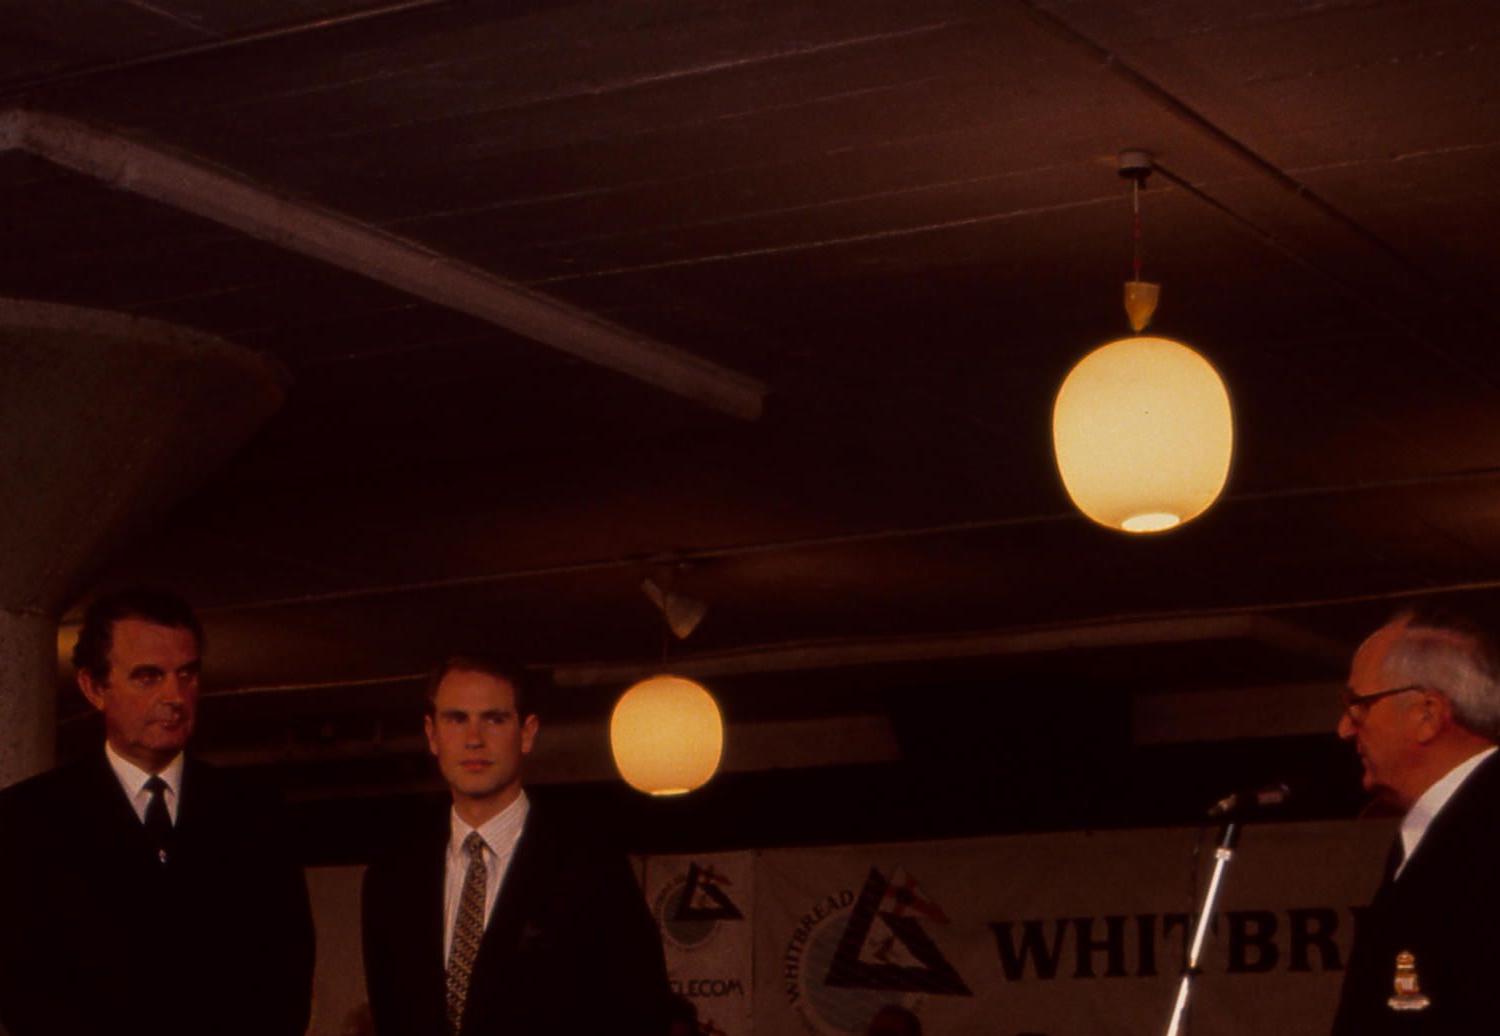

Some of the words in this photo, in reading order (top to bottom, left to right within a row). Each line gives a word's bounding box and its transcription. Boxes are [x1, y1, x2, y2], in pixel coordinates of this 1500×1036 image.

[784, 889, 855, 1004] WHITBREAD
[987, 907, 1371, 980] WHITBR
[666, 979, 744, 998] ELECOM
